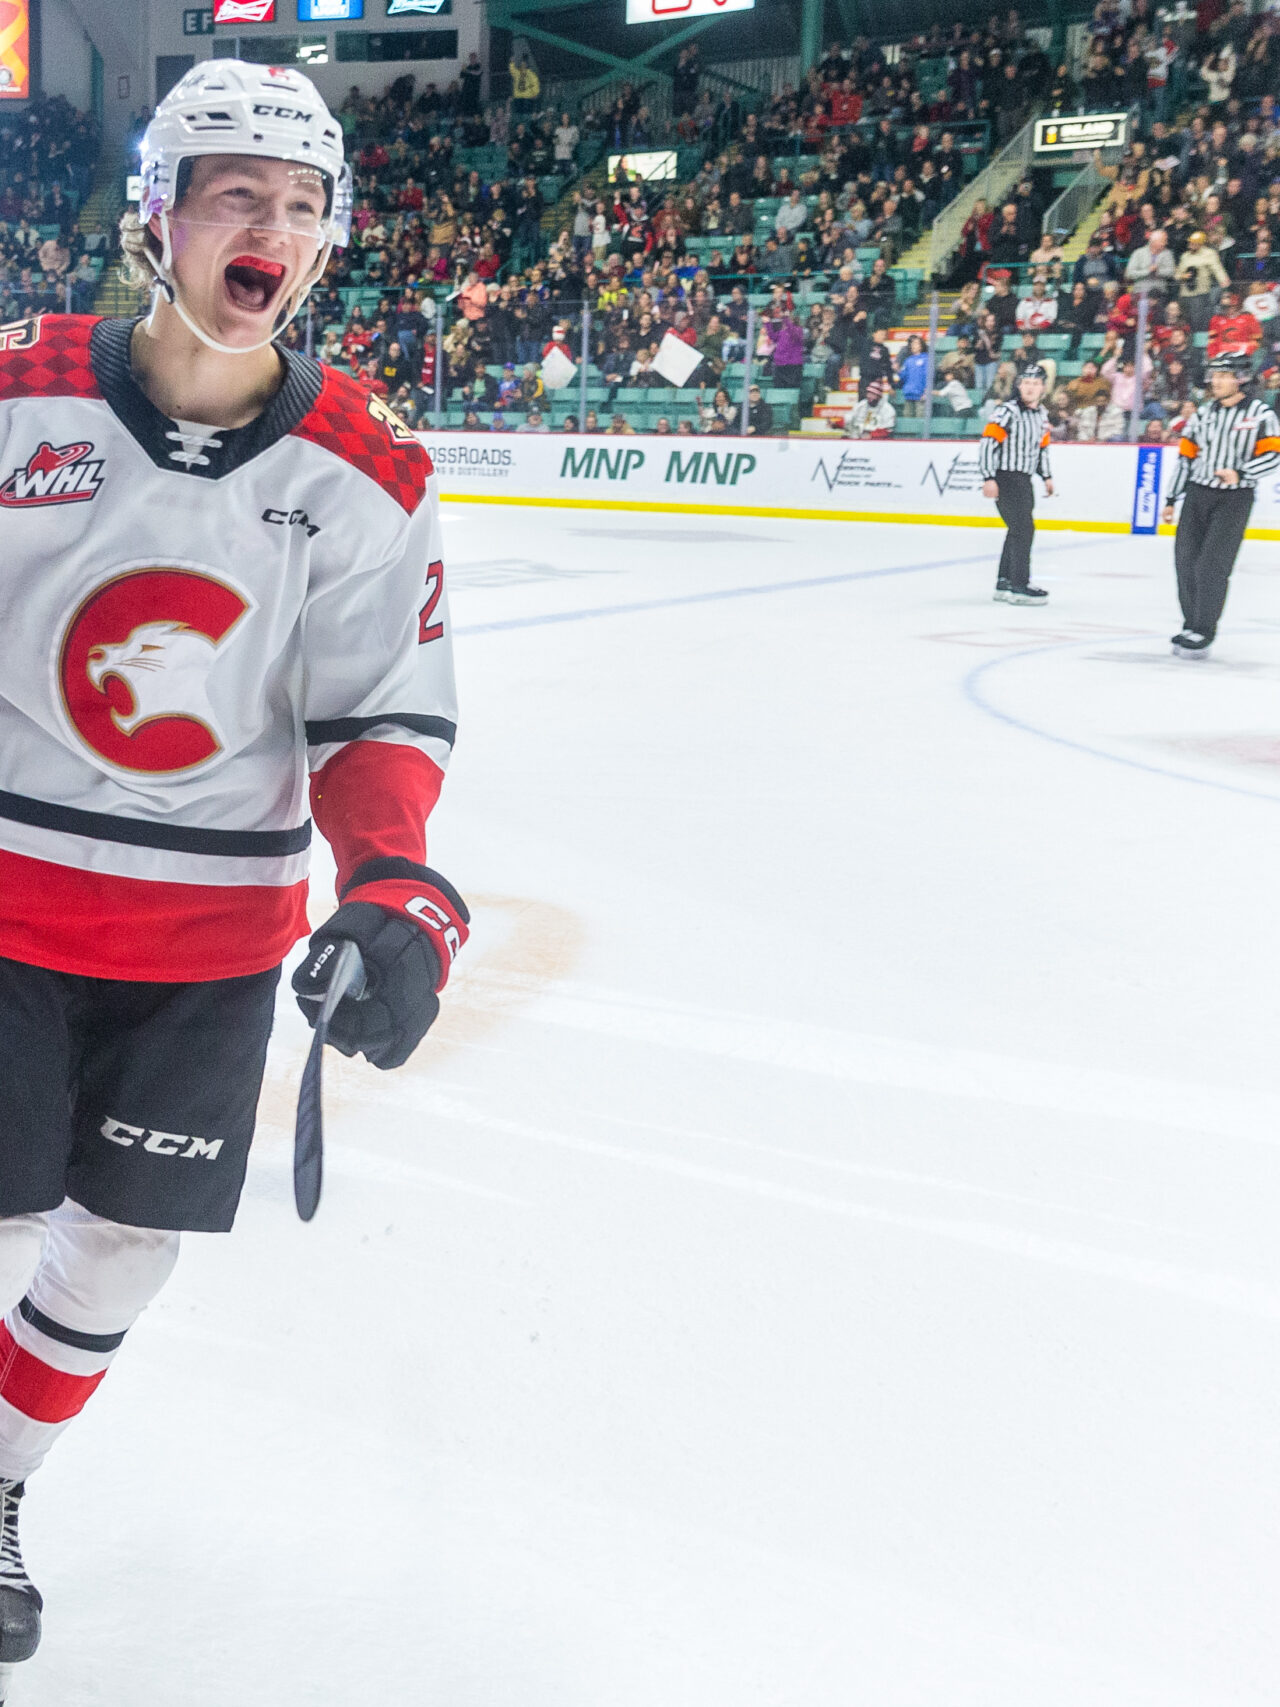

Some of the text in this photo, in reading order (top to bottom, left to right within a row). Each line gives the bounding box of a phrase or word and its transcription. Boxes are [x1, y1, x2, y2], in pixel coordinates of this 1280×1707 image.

[253, 104, 313, 122] CCM
[428, 446, 512, 466] OSSROADS
[560, 446, 645, 481] MNP
[665, 449, 756, 486] MNP
[15, 458, 107, 499] WHL
[404, 896, 460, 962] CC
[309, 944, 336, 978] CCM
[99, 1115, 224, 1160] CCM
